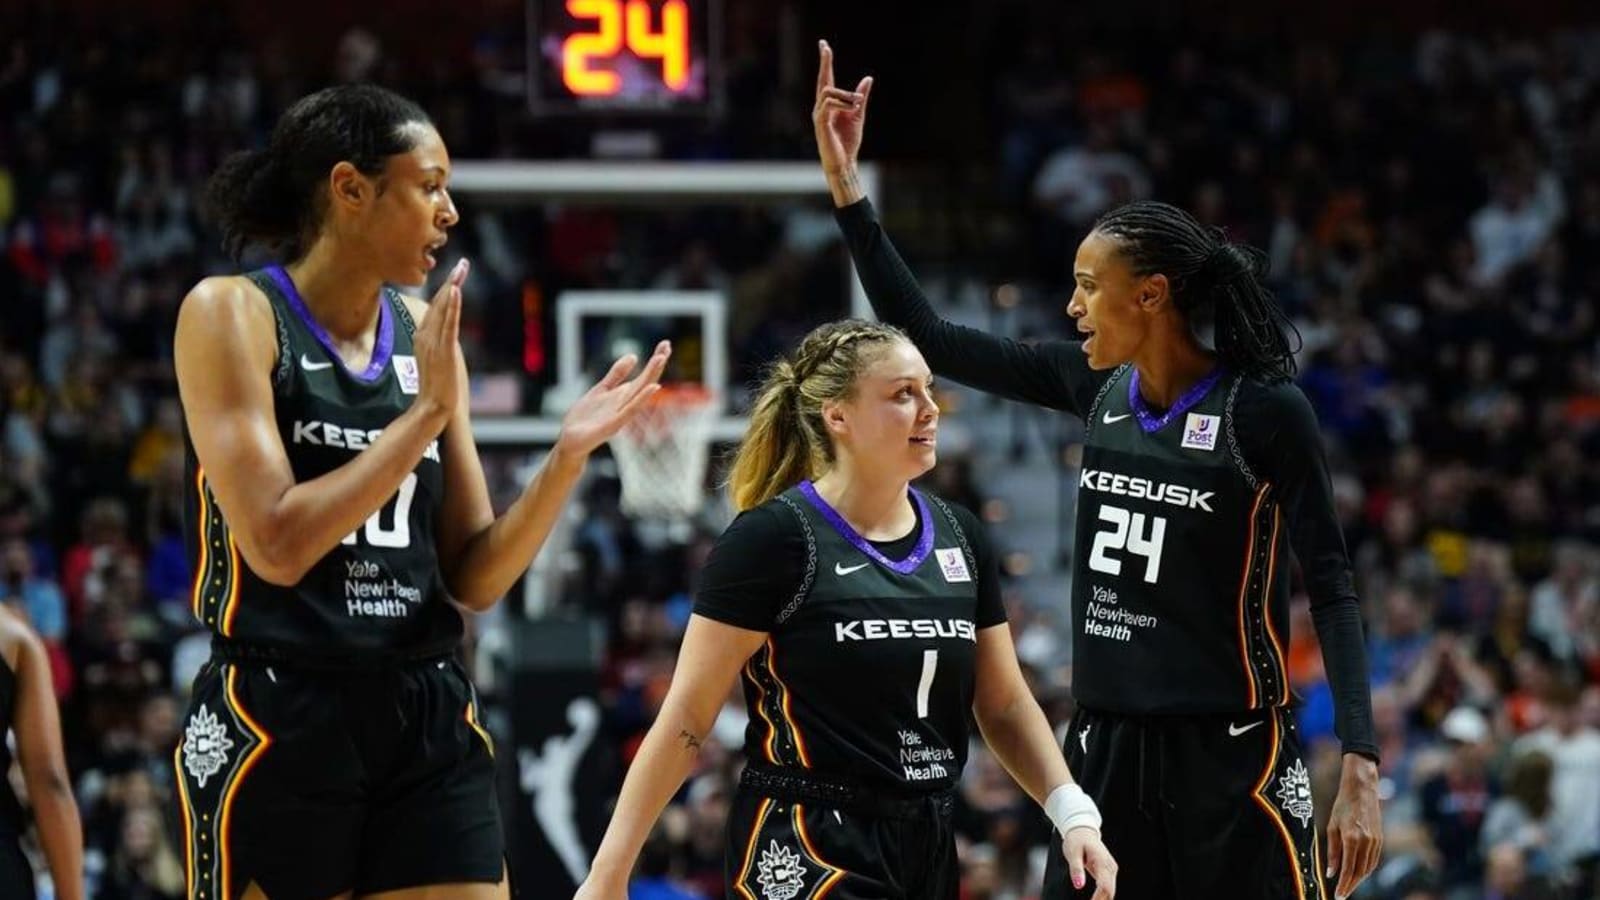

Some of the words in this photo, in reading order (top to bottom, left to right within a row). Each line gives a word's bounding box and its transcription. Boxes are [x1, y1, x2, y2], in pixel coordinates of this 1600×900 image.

[562, 0, 690, 95] 24
[1187, 430, 1212, 442] Post
[1079, 468, 1216, 512] KEESUSK
[341, 472, 418, 548] 0
[1088, 504, 1167, 584] 24
[345, 560, 380, 578] Yale
[1092, 585, 1118, 604] Yale
[346, 599, 408, 617] Health
[1086, 601, 1158, 628] NewHaven
[1084, 618, 1132, 641] Health
[916, 650, 938, 719] 1
[903, 762, 948, 780] Health
